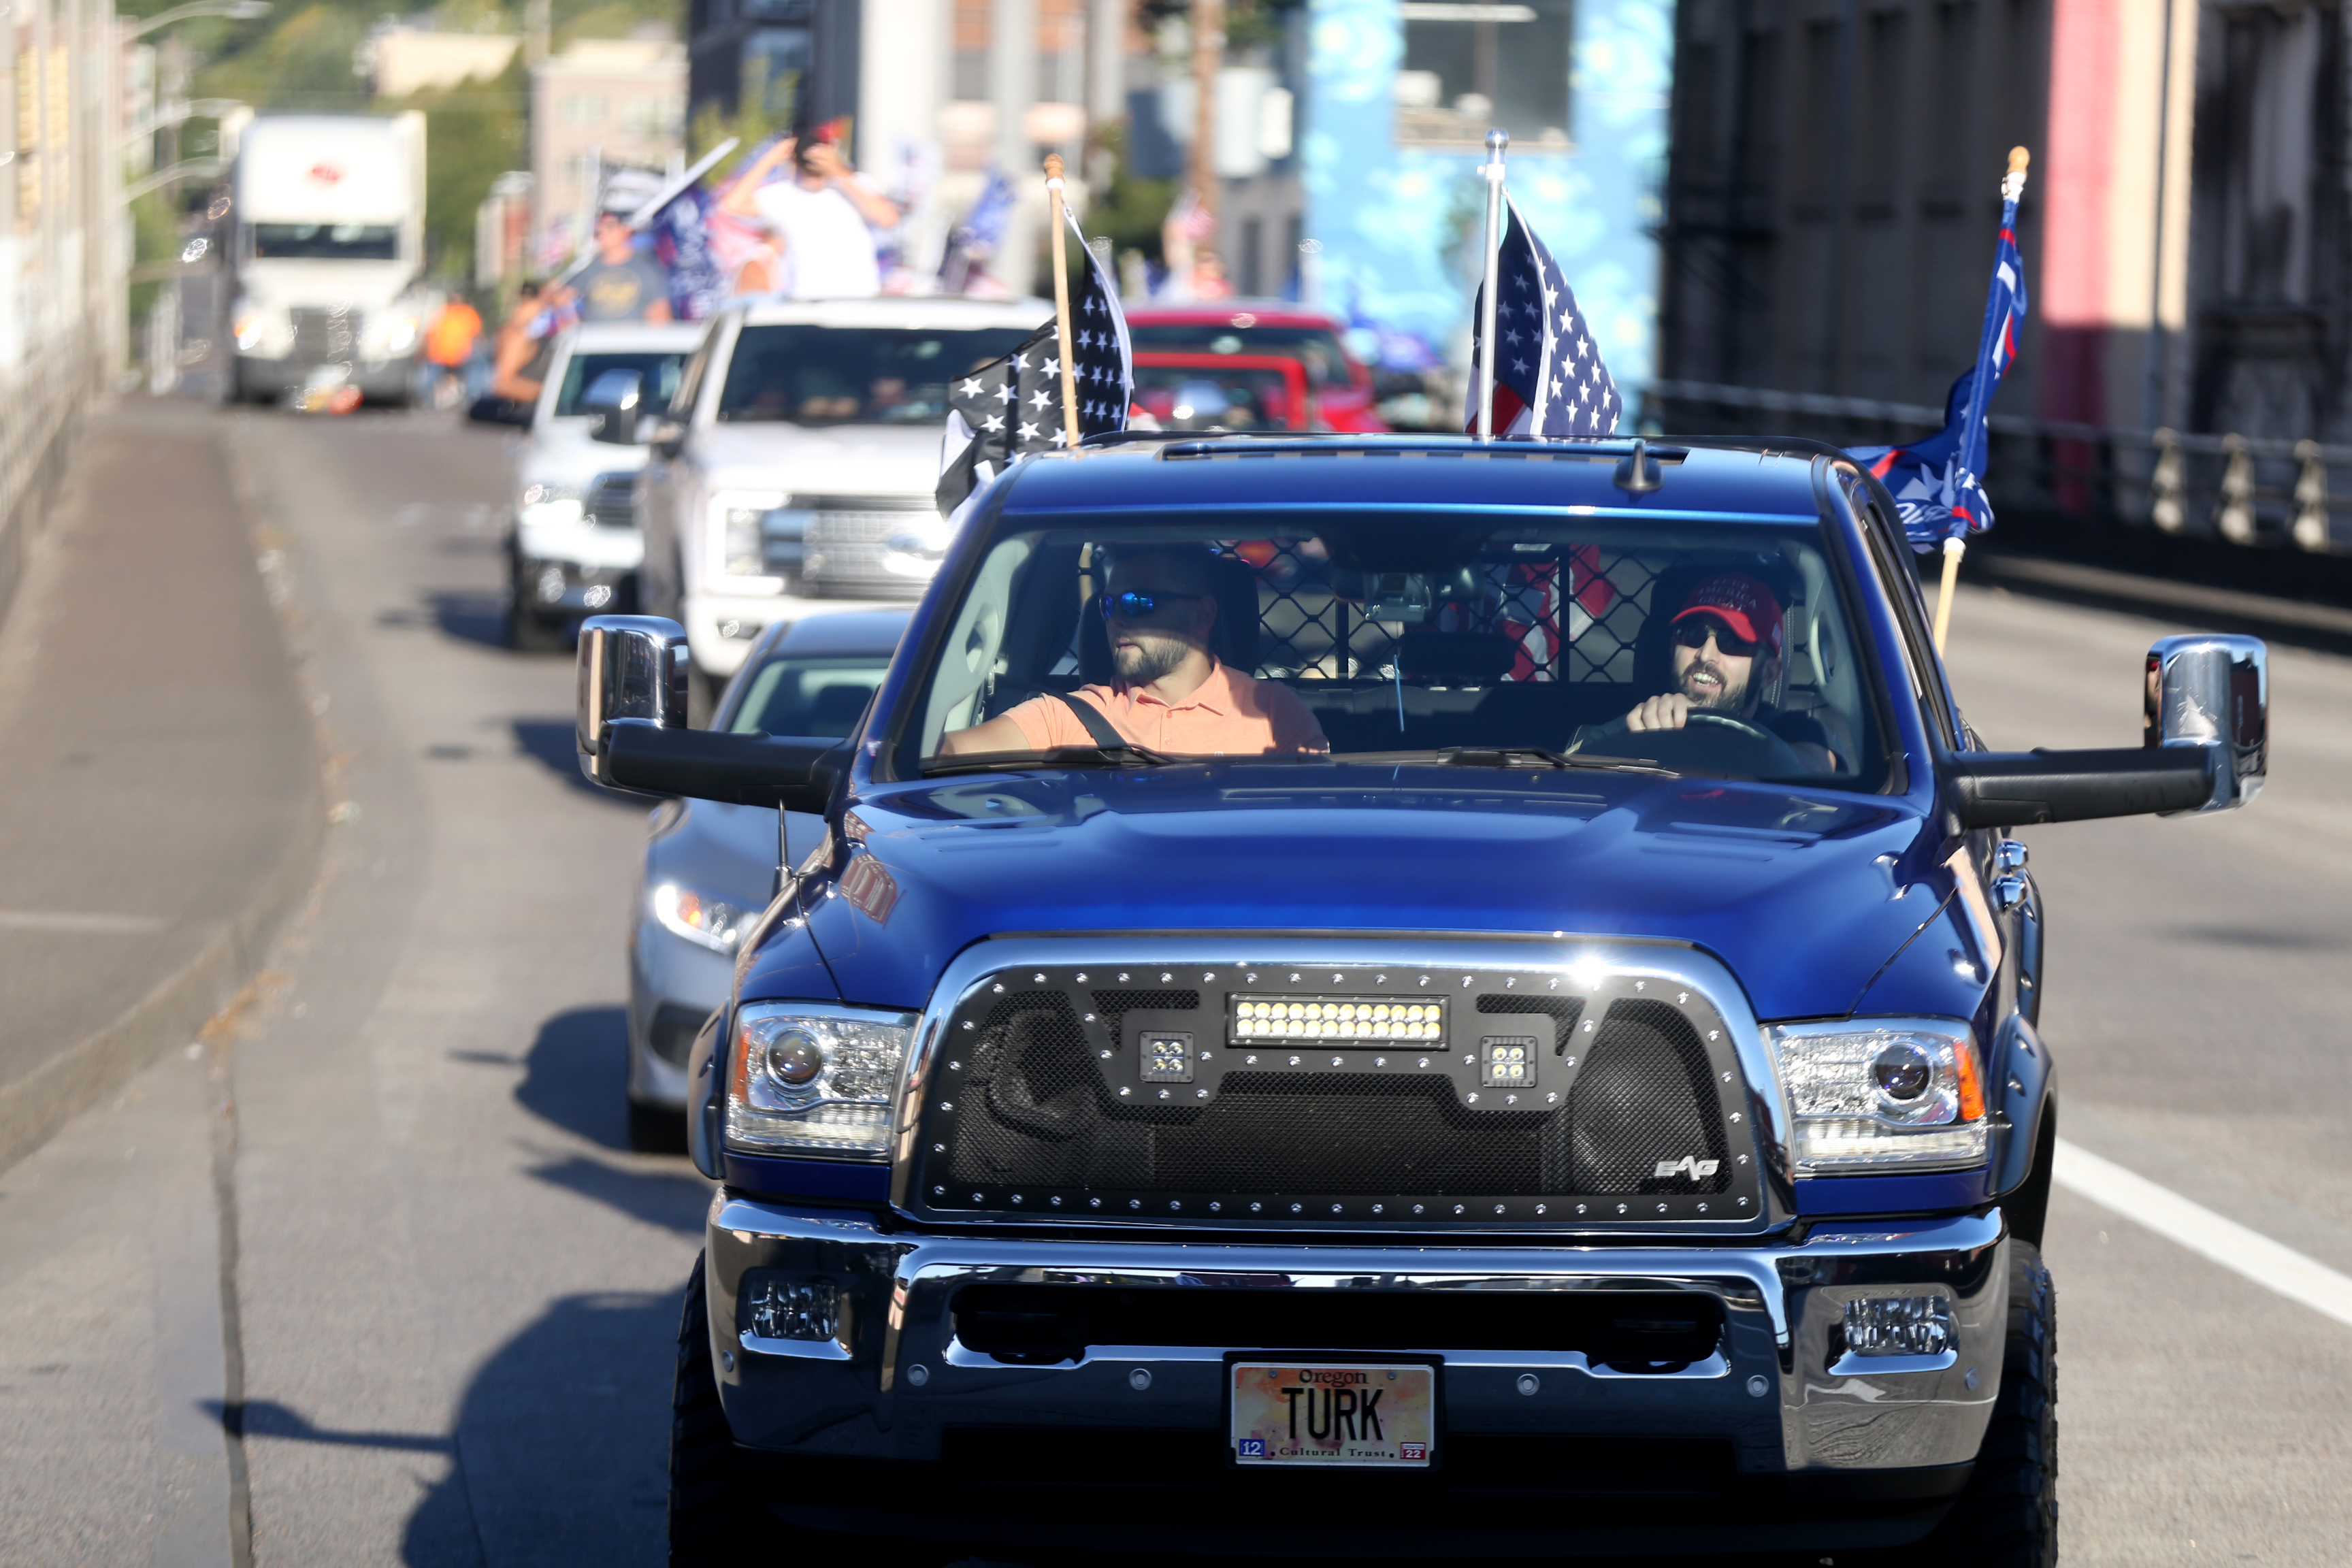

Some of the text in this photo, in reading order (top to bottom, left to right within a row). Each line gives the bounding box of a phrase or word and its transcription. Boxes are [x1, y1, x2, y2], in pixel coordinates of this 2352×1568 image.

[1713, 578, 1750, 590] KEEP
[1698, 586, 1757, 609] AMERICA
[1699, 595, 1747, 612] GREAT
[1299, 1369, 1369, 1388] Oregon
[1281, 1387, 1384, 1441] TURK
[1243, 1441, 1261, 1456] 12
[1279, 1448, 1386, 1458] Cultural Trust
[1405, 1450, 1421, 1458] 22
